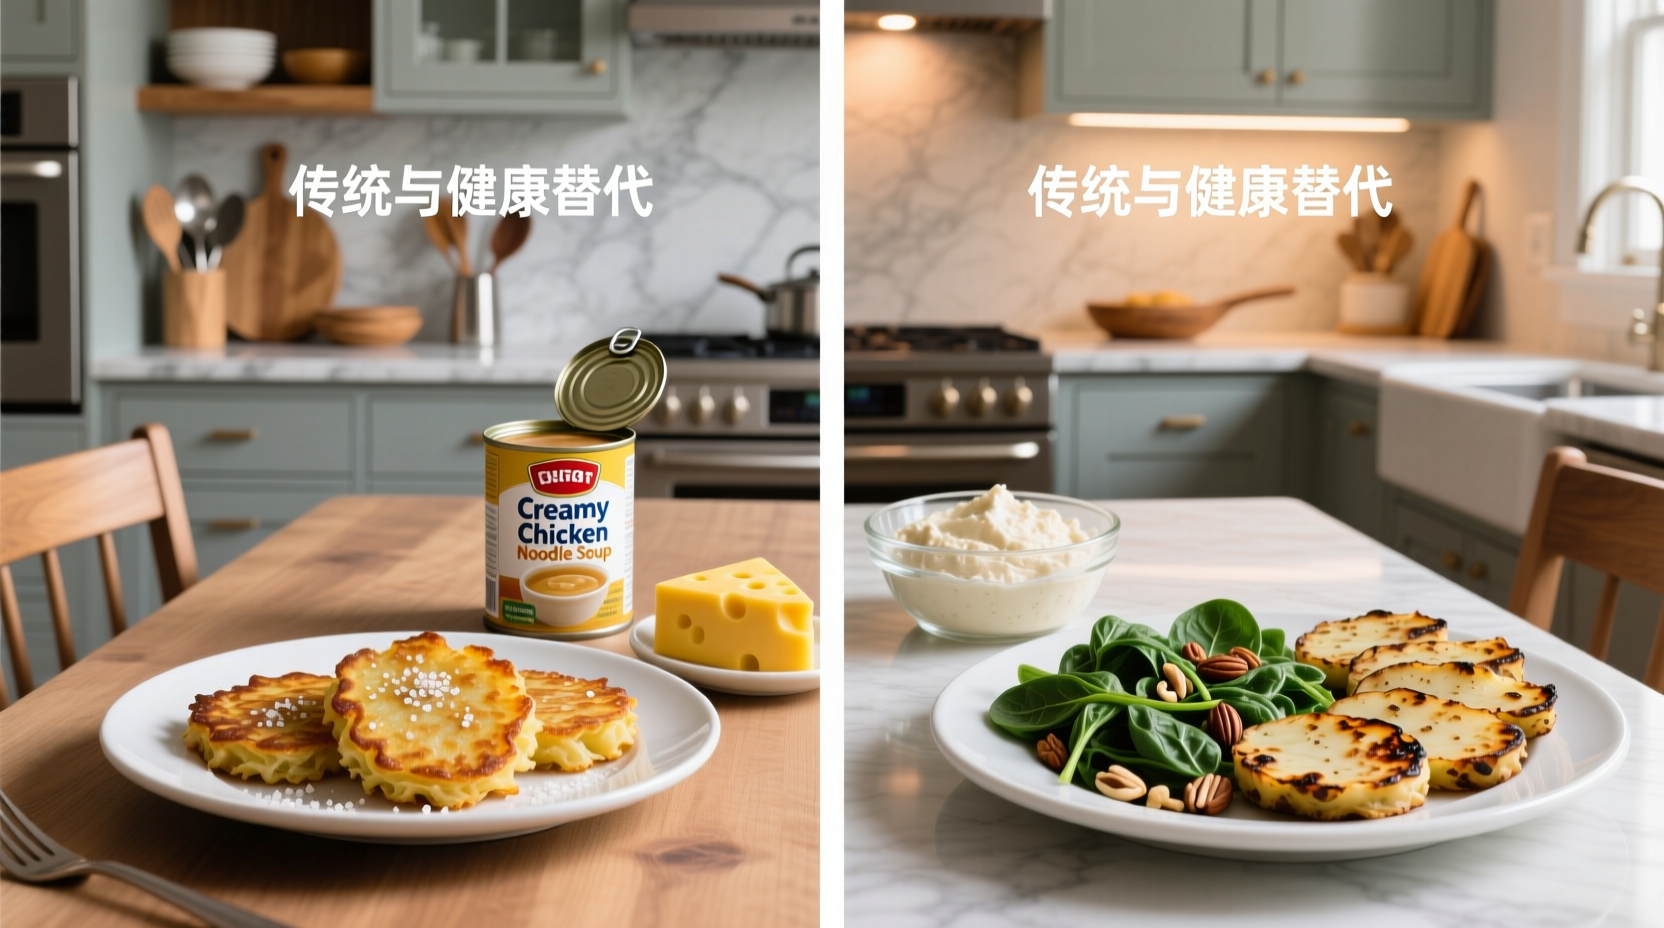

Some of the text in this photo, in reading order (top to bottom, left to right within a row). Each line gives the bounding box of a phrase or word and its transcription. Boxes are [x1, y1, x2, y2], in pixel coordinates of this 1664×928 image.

[517, 496, 610, 524] Creamy
[517, 522, 609, 545] Chicken
[517, 545, 612, 562] Noodle Soup
